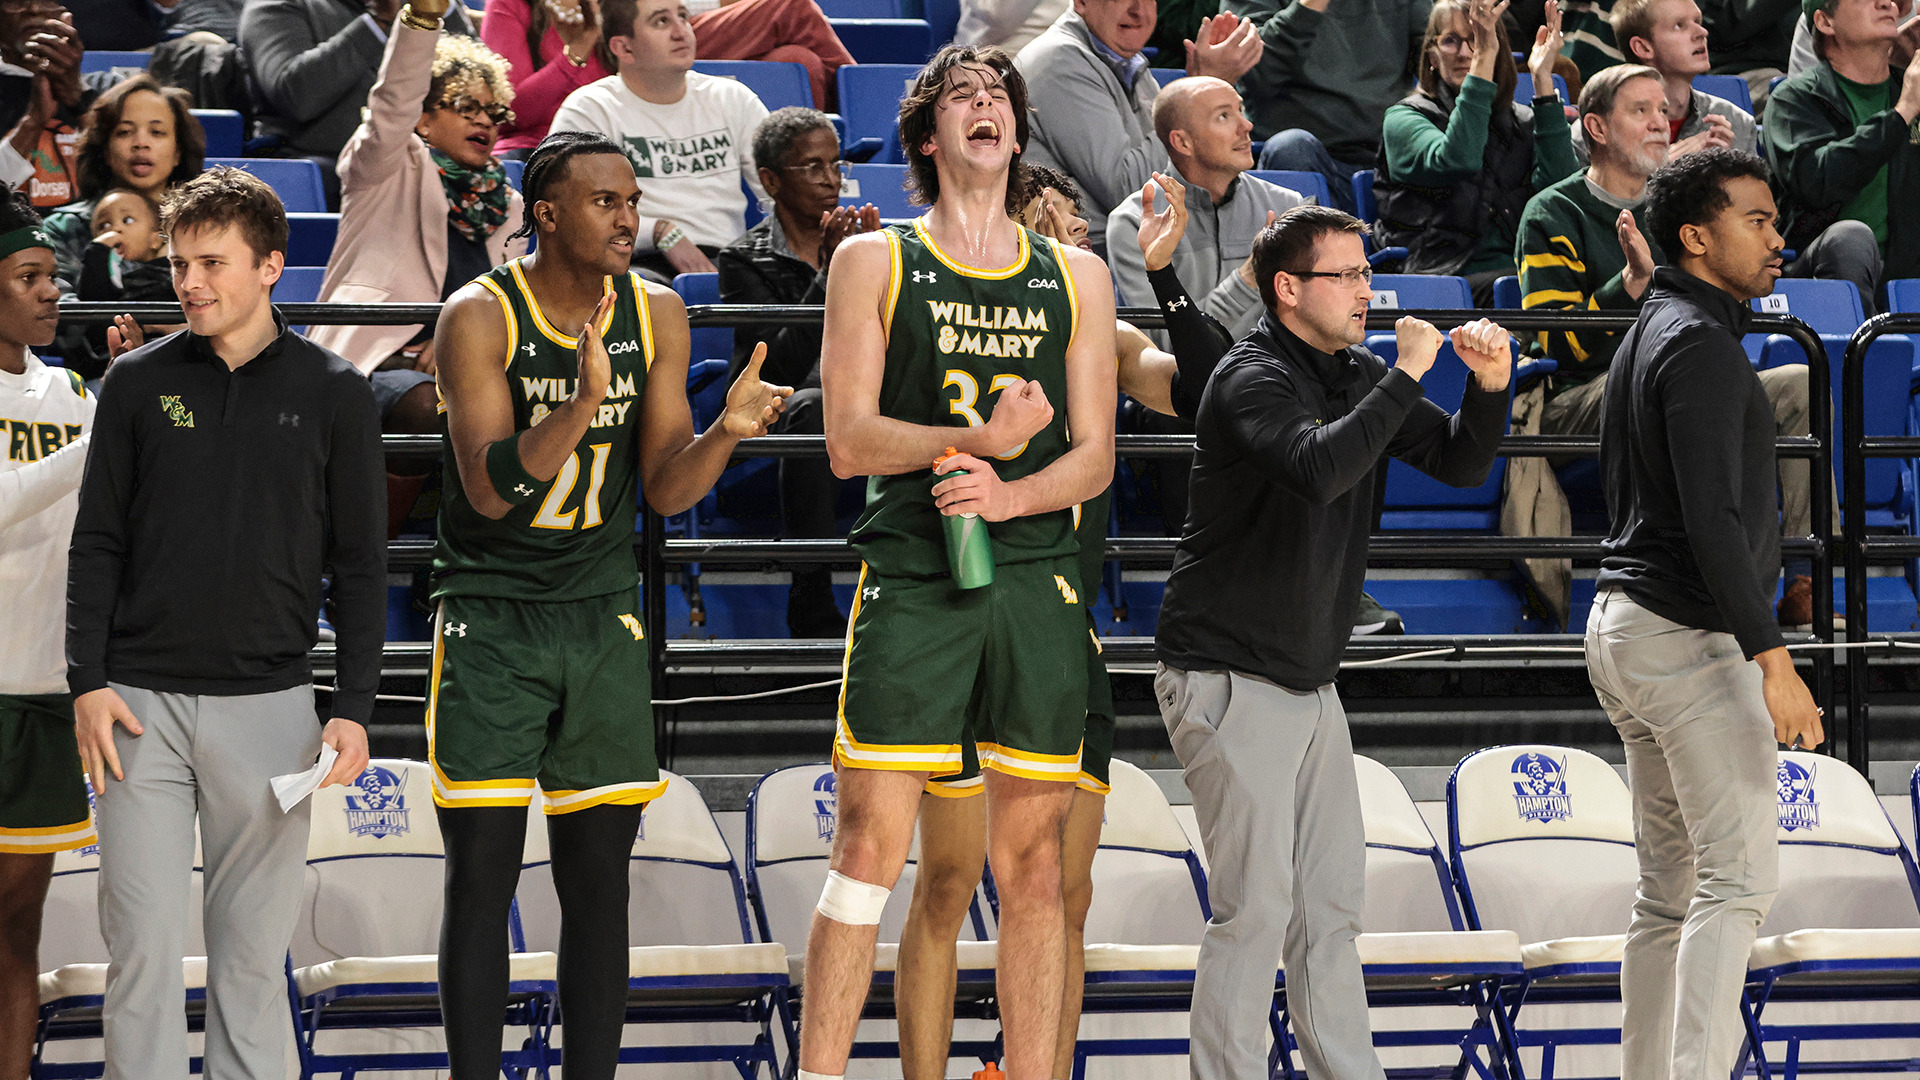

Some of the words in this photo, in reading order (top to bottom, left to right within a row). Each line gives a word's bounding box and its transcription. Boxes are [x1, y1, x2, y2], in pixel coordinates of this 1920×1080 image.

[650, 134, 731, 156] WILIAM
[31, 178, 70, 199] Dorsey
[1027, 279, 1059, 290] CAA
[1380, 294, 1387, 304] 8
[1769, 298, 1780, 308] 10
[926, 300, 1050, 332] WILLIAM
[608, 339, 639, 354] CAA
[520, 372, 638, 402] WILAM
[0, 418, 83, 463] RIB
[530, 443, 612, 530] 21
[1517, 795, 1570, 815] HAMPTON
[1777, 804, 1817, 823] MPTON
[348, 811, 407, 829] HAMPTON
